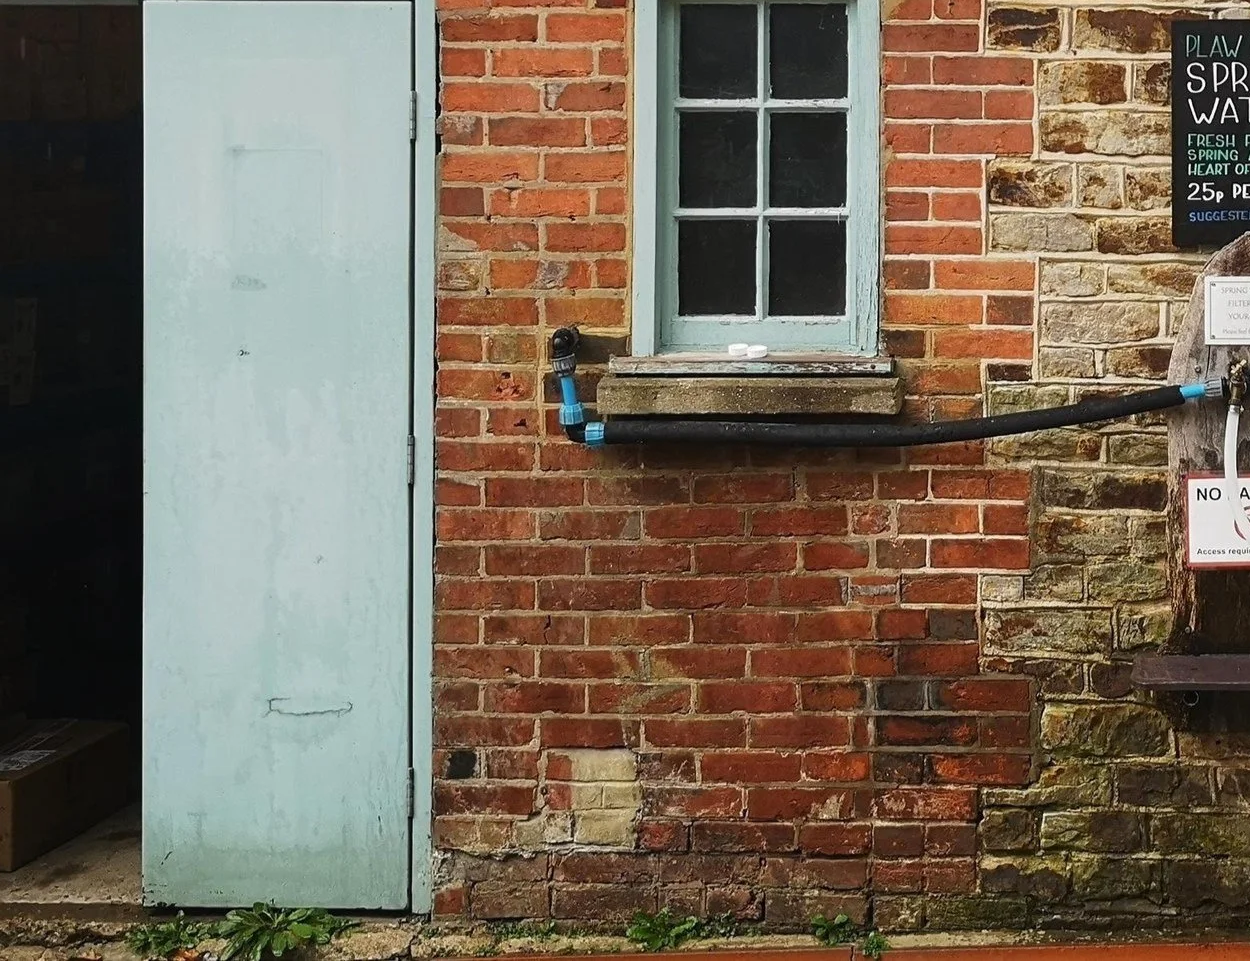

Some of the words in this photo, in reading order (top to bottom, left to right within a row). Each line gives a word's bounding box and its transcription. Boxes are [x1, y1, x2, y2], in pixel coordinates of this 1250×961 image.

[1185, 34, 1243, 58] PLAW
[1187, 134, 1236, 148] FRESH
[1187, 149, 1239, 161] SPRING
[1187, 163, 1231, 176] HEART
[1187, 182, 1224, 203] 25p
[1221, 286, 1248, 294] SPRING
[1228, 312, 1249, 320] YOUR
[1196, 487, 1221, 501] NO
[1197, 547, 1226, 555] Access
